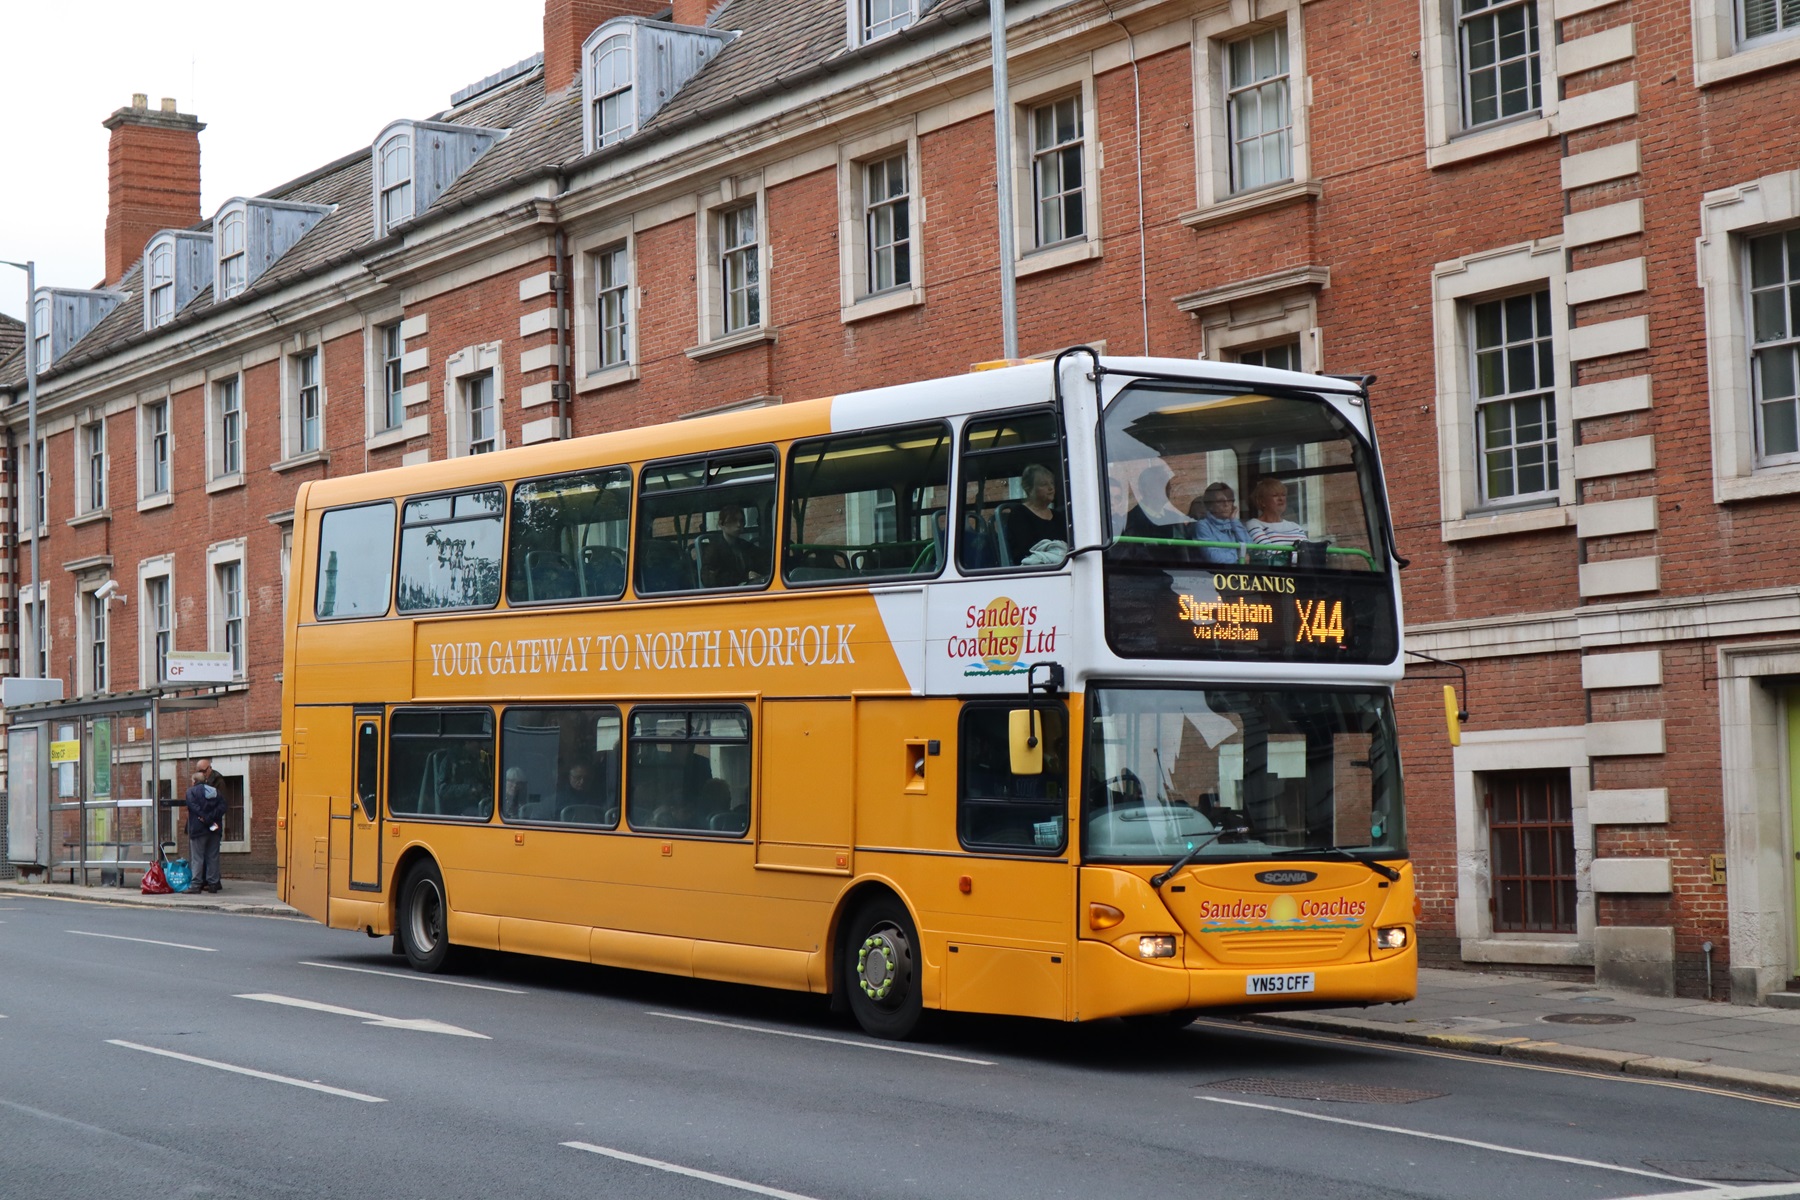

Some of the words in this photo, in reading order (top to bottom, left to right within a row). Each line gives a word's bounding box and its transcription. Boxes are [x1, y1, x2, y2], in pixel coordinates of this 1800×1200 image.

[1213, 573, 1295, 594] OCEANUS
[965, 600, 1038, 629] Sanders
[1178, 594, 1273, 624] Sheringham
[1193, 622, 1212, 639] via
[1296, 599, 1345, 643] X44
[430, 642, 483, 676] YOUR
[487, 636, 592, 675] GATEWAY
[596, 634, 629, 671] TO
[633, 630, 722, 670] NORTH
[728, 624, 856, 667] NORFOLK
[947, 630, 1019, 658] Coaches
[1025, 625, 1057, 654] Ltd
[170, 666, 185, 675] CF
[1264, 873, 1308, 883] SCANIA
[1200, 898, 1268, 919] Sanders
[1301, 896, 1367, 918] Coaches
[1252, 976, 1284, 992] YN53
[1287, 975, 1310, 990] CFF
